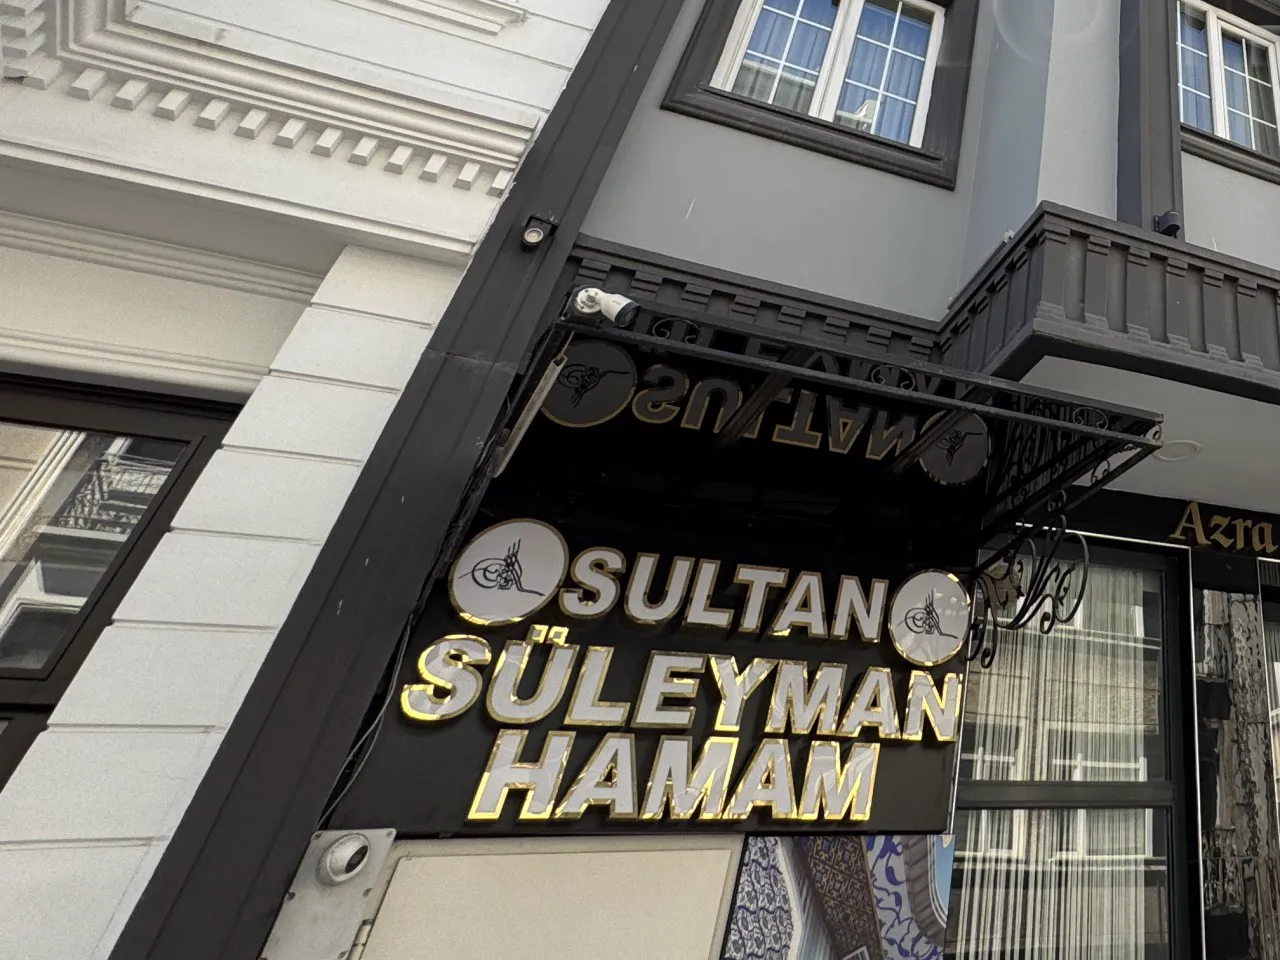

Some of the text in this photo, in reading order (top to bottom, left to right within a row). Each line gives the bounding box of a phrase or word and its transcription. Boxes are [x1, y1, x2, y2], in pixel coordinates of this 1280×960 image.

[1169, 500, 1279, 553] Azra
[559, 547, 889, 642] SULTAN
[400, 625, 962, 741] SÜLEYMAN
[467, 729, 880, 821] HAMAM
